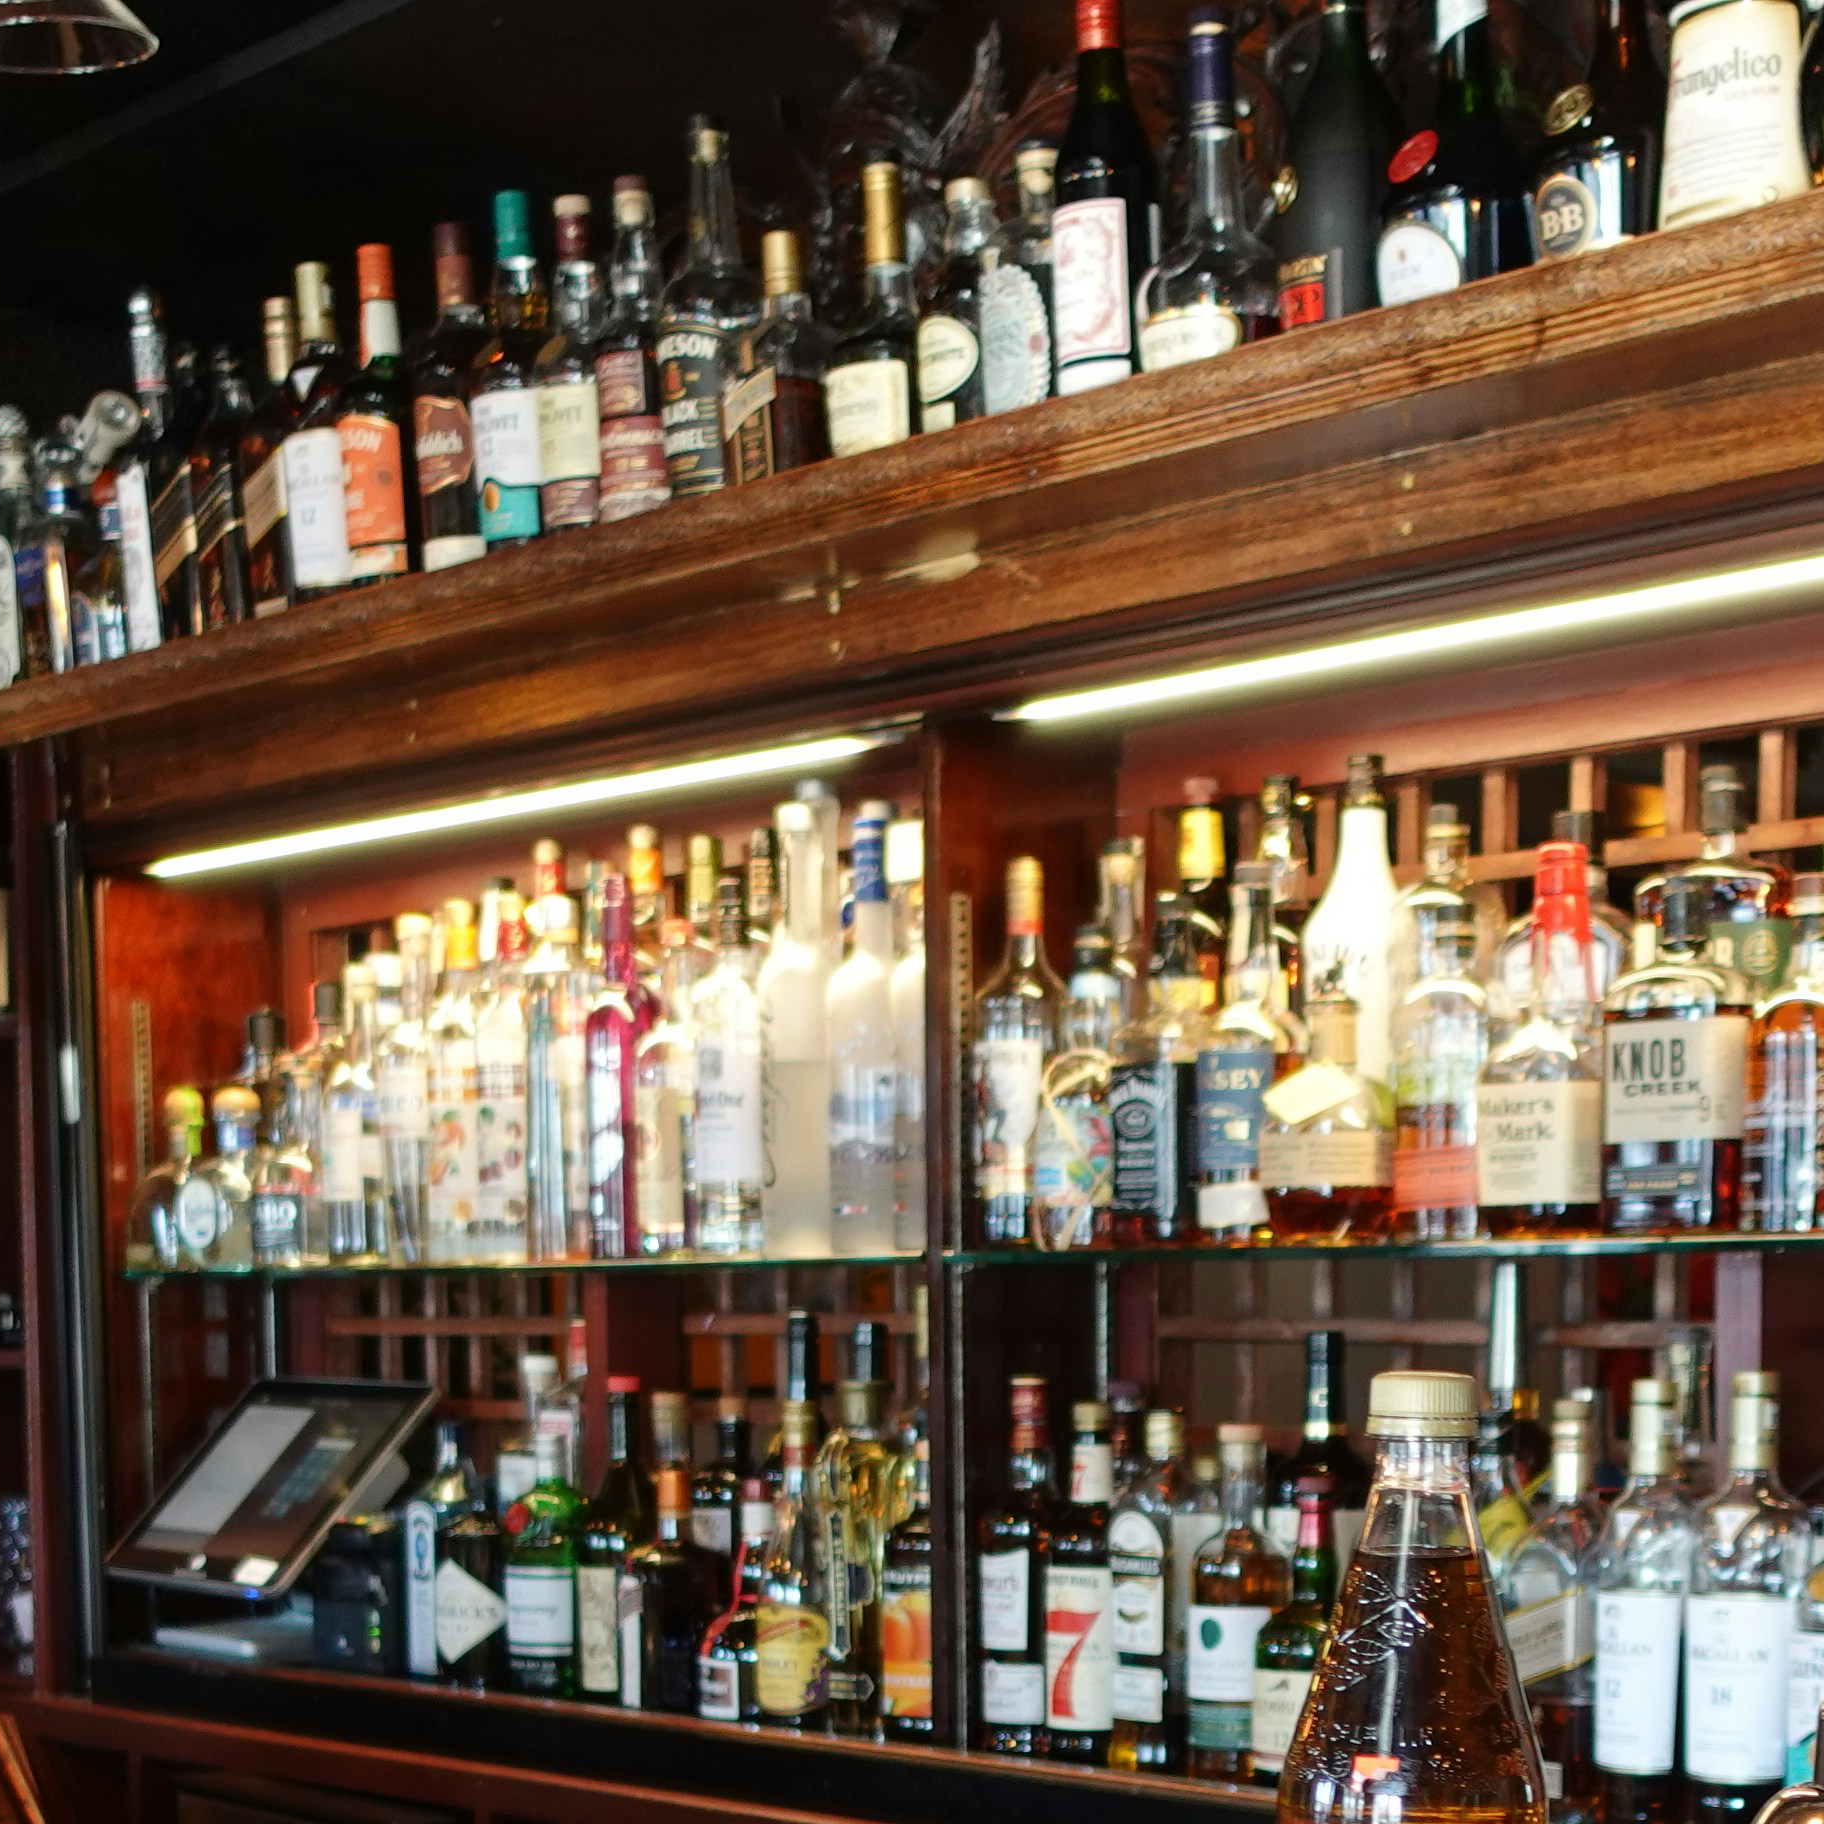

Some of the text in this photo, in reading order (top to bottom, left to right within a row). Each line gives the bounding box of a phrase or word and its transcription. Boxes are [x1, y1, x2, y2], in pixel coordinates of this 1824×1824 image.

[1610, 1038, 1686, 1082] KNOB
[1623, 1080, 1702, 1098] CREEK
[1479, 1098, 1555, 1117] Maker's
[1046, 1610, 1102, 1718] 7
